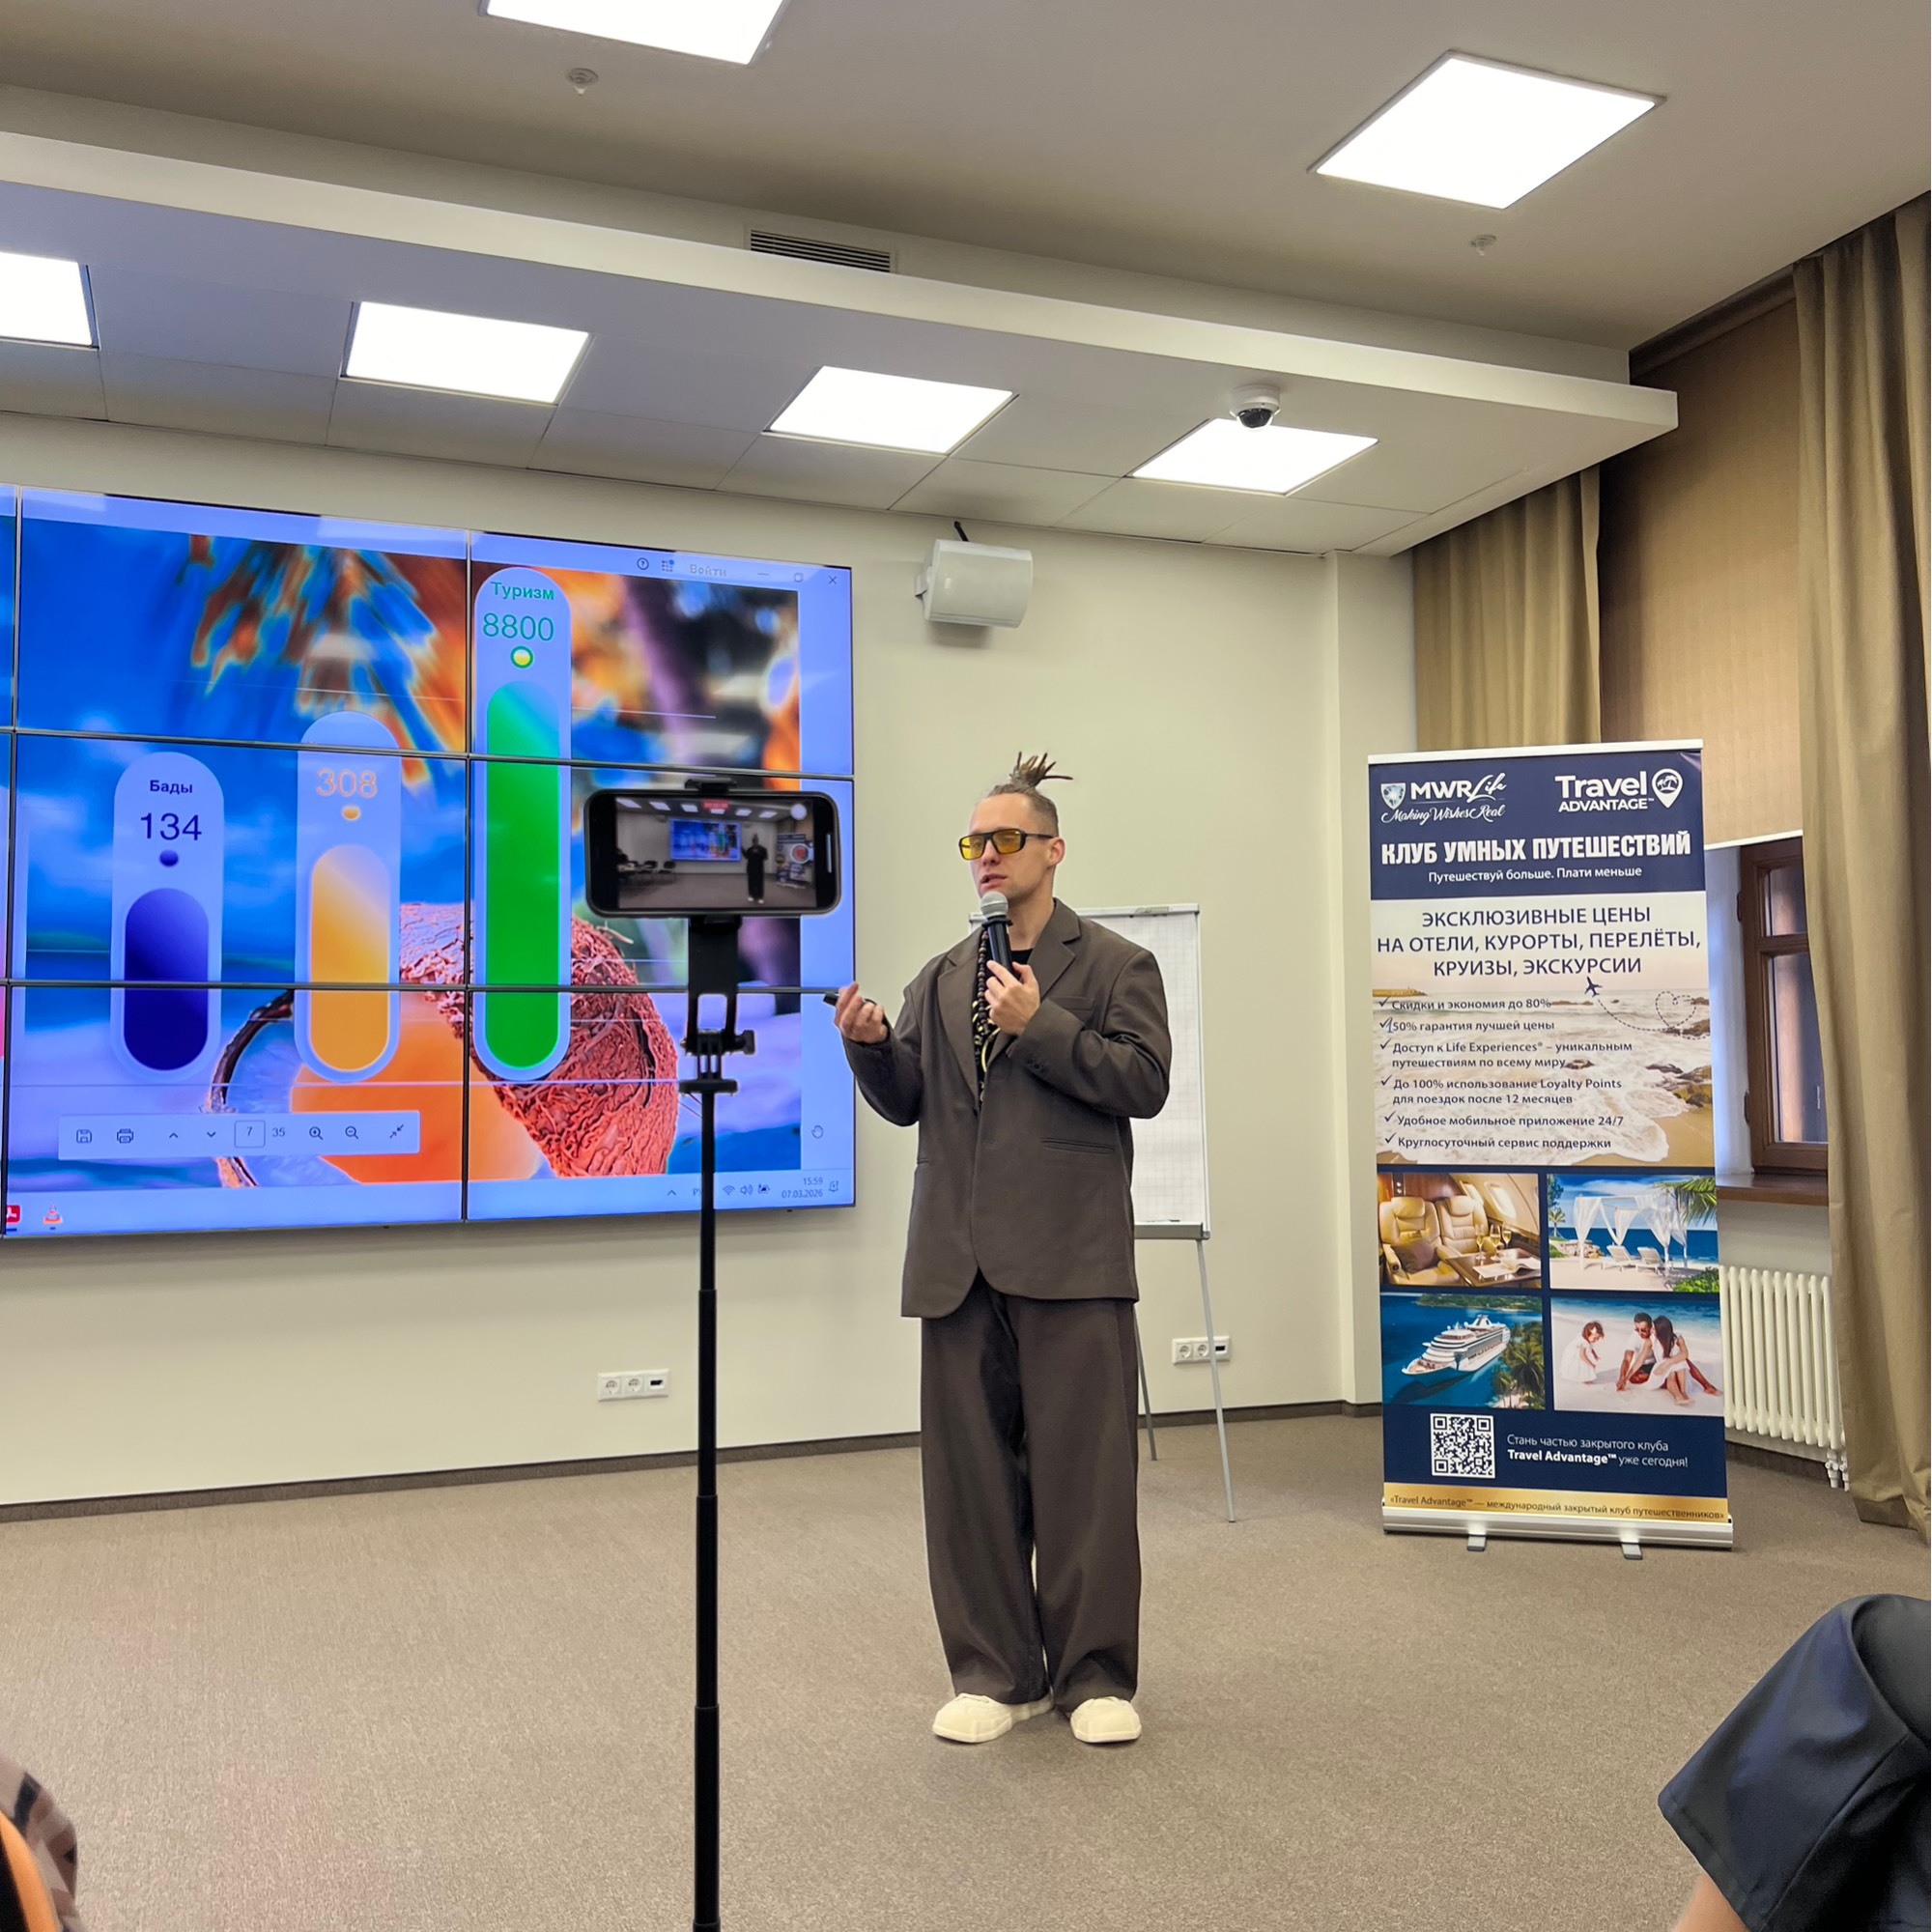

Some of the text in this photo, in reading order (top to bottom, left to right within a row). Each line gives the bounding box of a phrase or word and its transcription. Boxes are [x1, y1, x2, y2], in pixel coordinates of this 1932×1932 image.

[689, 564, 727, 578] Войти
[491, 582, 555, 601] Туризм
[483, 612, 555, 641] 8800
[149, 780, 193, 795] Бады
[315, 767, 378, 799] 308
[1410, 772, 1507, 804] MWR Life
[1554, 771, 1647, 799] Travel
[1380, 804, 1506, 826] Making Wishes Real
[140, 812, 202, 840] 134
[1381, 831, 1691, 865] КЛУБ УМНЫХ ПУТЕШЕСТВИЙ
[1428, 867, 1642, 885] Путешествуй больше. Плати меньше
[1421, 906, 1651, 928] ЭКСКЛЮЗИВНЫЕ ЦЕНЫ
[1377, 927, 1701, 953] НА ОТЕЛИ, КУРОРТЫ, ПЕРЕЛЁТЫ,
[1434, 956, 1642, 978] КРУИЗЫ, ЭКСКУРСИИ
[1392, 1000, 1435, 1011] Скидки
[1447, 1000, 1505, 1009] экономия
[1508, 1000, 1523, 1010] до
[1525, 998, 1551, 1009] 80%
[1419, 1023, 1473, 1033] гарантия
[1474, 1020, 1520, 1032] лучшей
[1522, 1021, 1554, 1032] цены
[1393, 1043, 1435, 1055] Доступ
[1446, 1042, 1466, 1052] Life
[1555, 1041, 1634, 1054] уникальным
[1392, 1059, 1566, 1070] путешествиям по всему миру
[1393, 1078, 1623, 1091] До 100% использование Loyalty Points
[1392, 1094, 1574, 1106] для поездок после 12 месяцев
[1397, 1114, 1625, 1128] Удобное мобильное приложение 24/7
[246, 1126, 286, 1138] 7 35
[1398, 1137, 1611, 1150] Круглосуточный сервис поддержки
[803, 1177, 824, 1186] 15:59
[781, 1188, 824, 1199] 07.03.2026
[1507, 1434, 1669, 1453] Стань частью закрытого клуба
[1507, 1449, 1543, 1462] Travel
[1618, 1457, 1639, 1466] уже
[1641, 1457, 1689, 1468] сегодня!
[1390, 1494, 1419, 1505] «Travel
[1487, 1502, 1562, 1513] международный
[1563, 1505, 1608, 1515] закрытый
[1609, 1506, 1632, 1516] клуб
[1633, 1508, 1724, 1520] путешественников»
